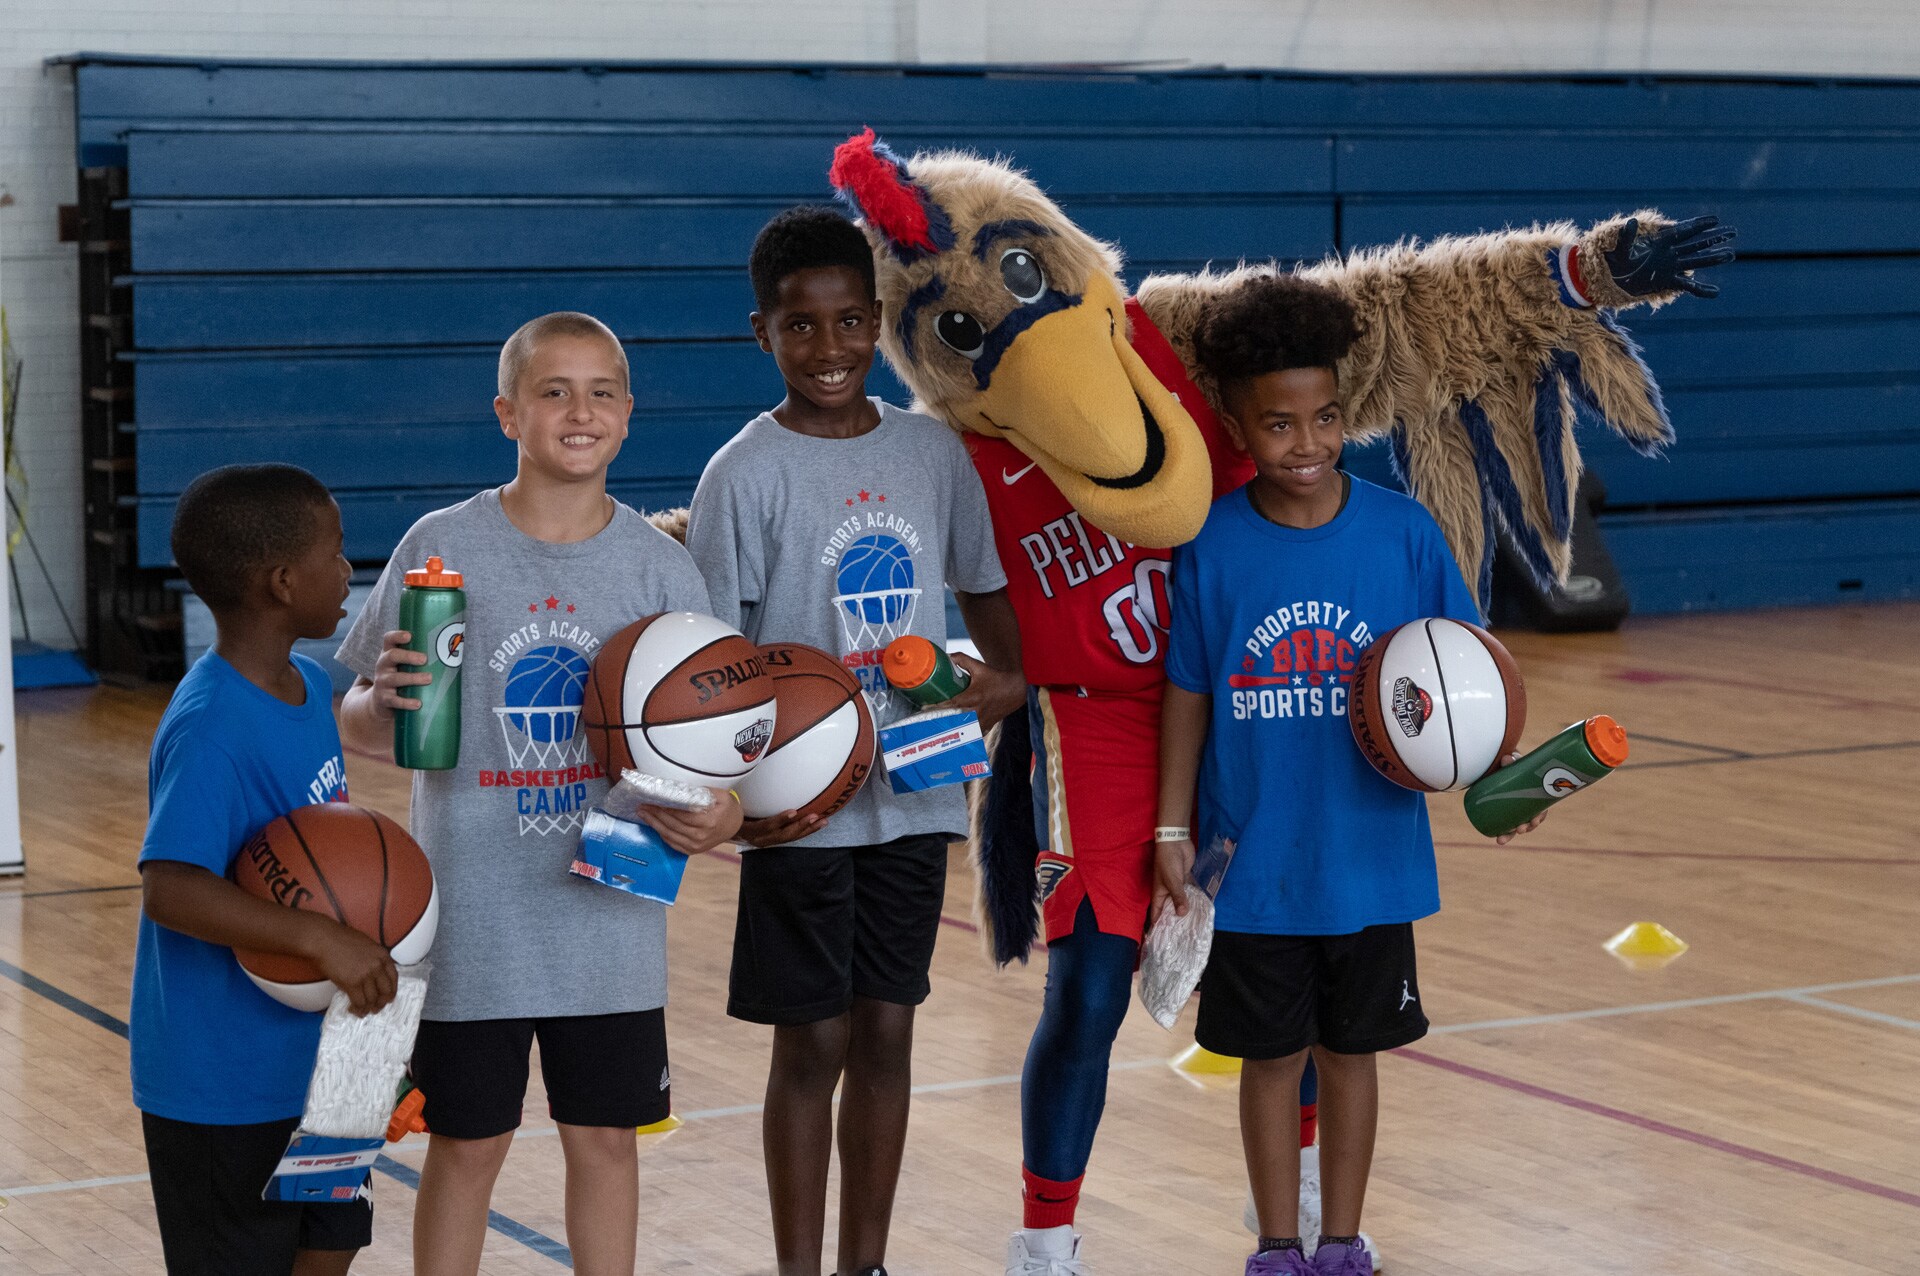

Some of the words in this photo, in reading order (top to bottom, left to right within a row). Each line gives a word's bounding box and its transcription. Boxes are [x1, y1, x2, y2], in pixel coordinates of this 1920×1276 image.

[820, 515, 862, 567] SPORTS
[867, 511, 923, 555] ACADEMY
[1019, 511, 1134, 599] PELI
[488, 622, 541, 673] SPORTS
[1245, 600, 1351, 658] PROPERTY
[1271, 628, 1355, 673] BREC
[1232, 687, 1324, 720] SPORTS
[1400, 716, 1418, 738] NEW
[517, 782, 587, 815] CAMP
